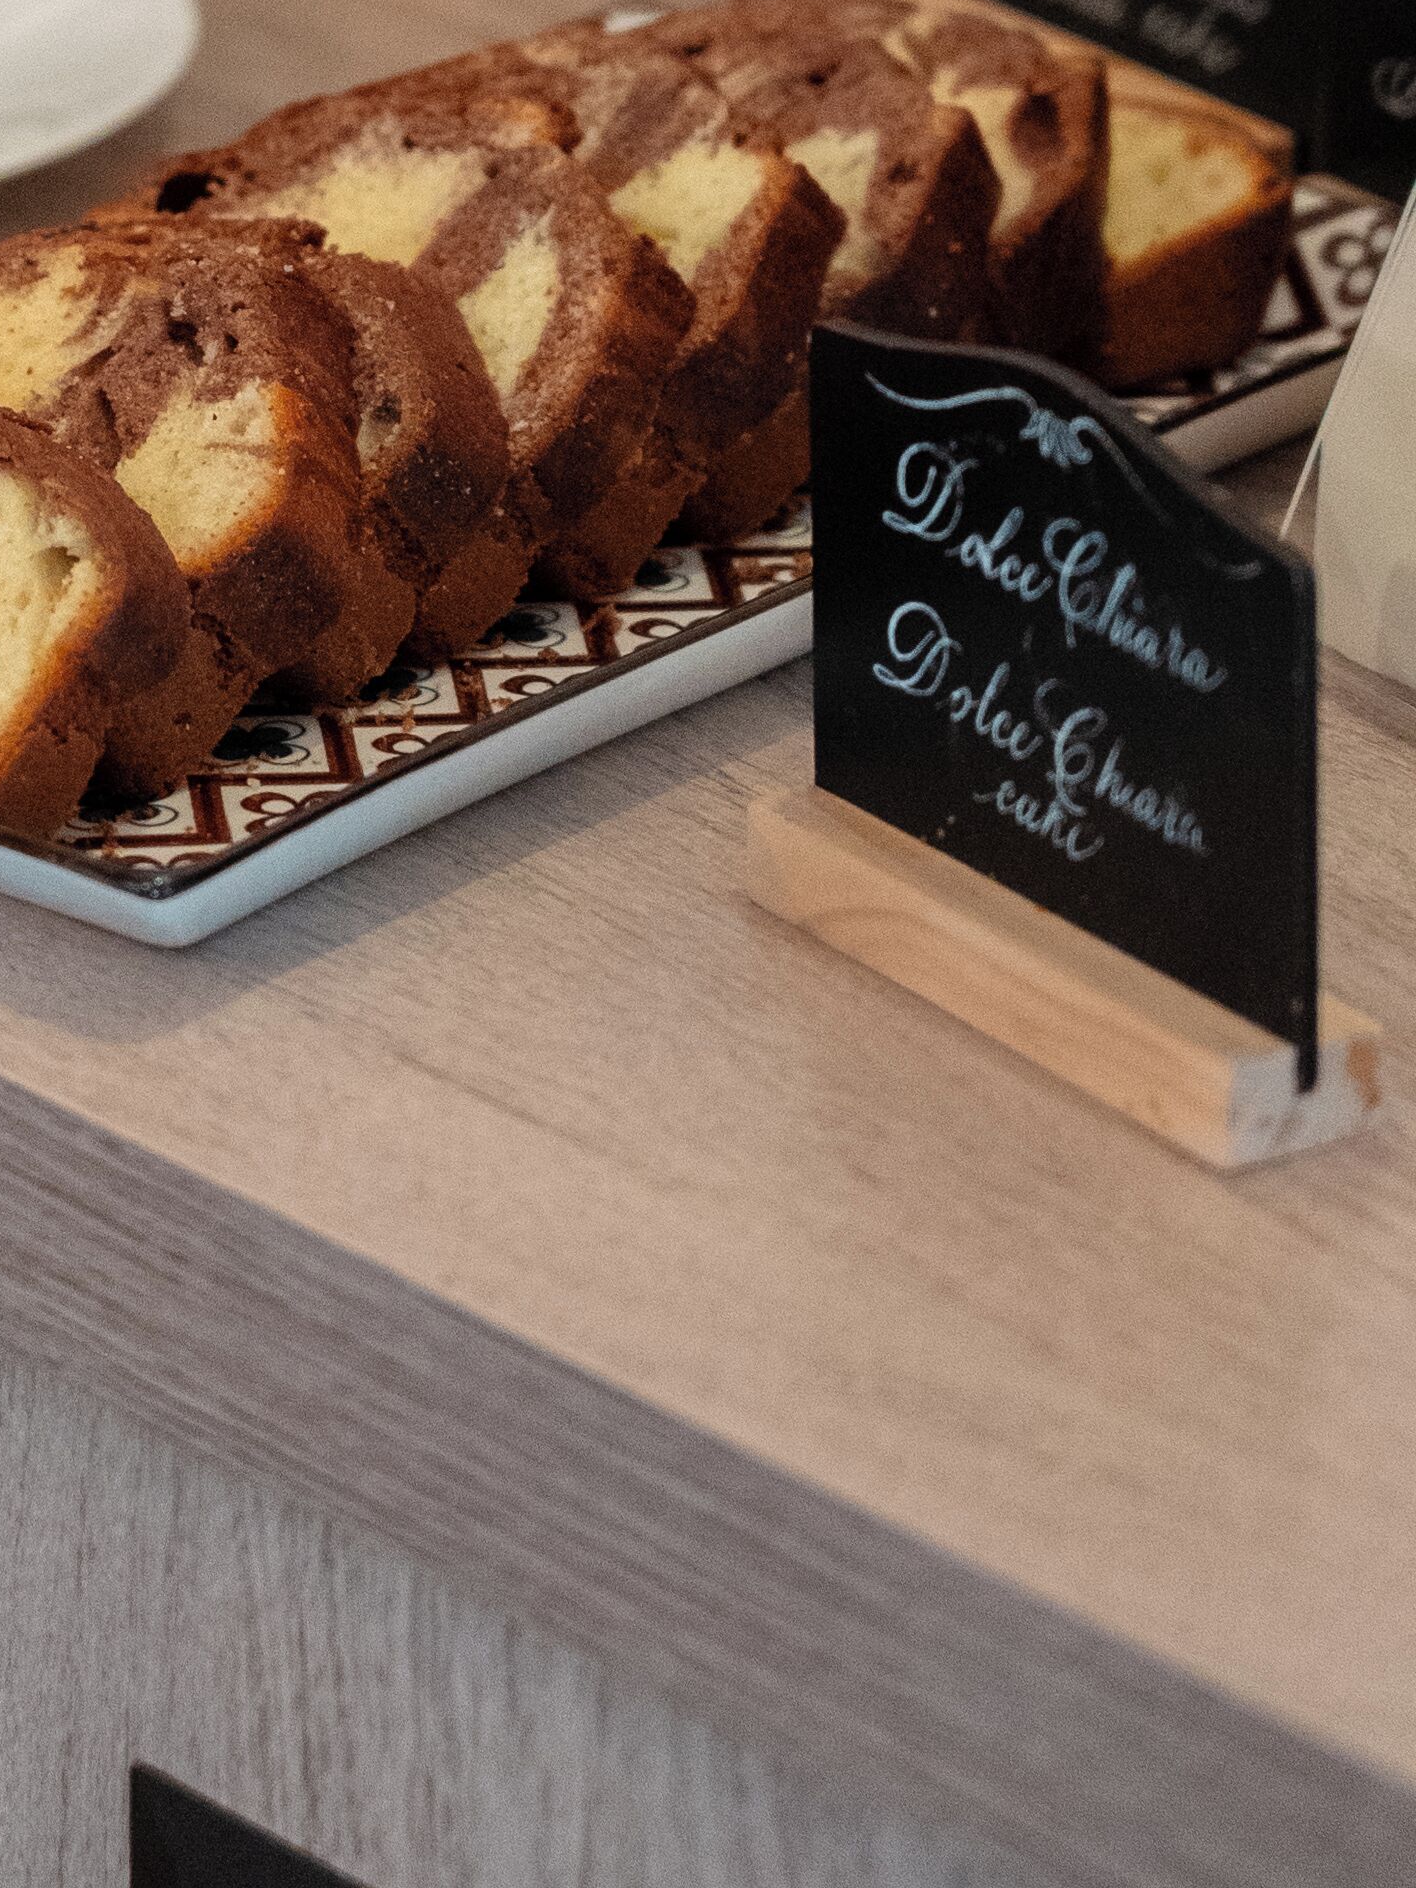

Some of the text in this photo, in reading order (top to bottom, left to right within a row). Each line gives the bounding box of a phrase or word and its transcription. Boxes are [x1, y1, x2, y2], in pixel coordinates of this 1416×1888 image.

[882, 441, 1229, 695] Dolce Chiara
[872, 600, 1210, 857] Dolce Chiara
